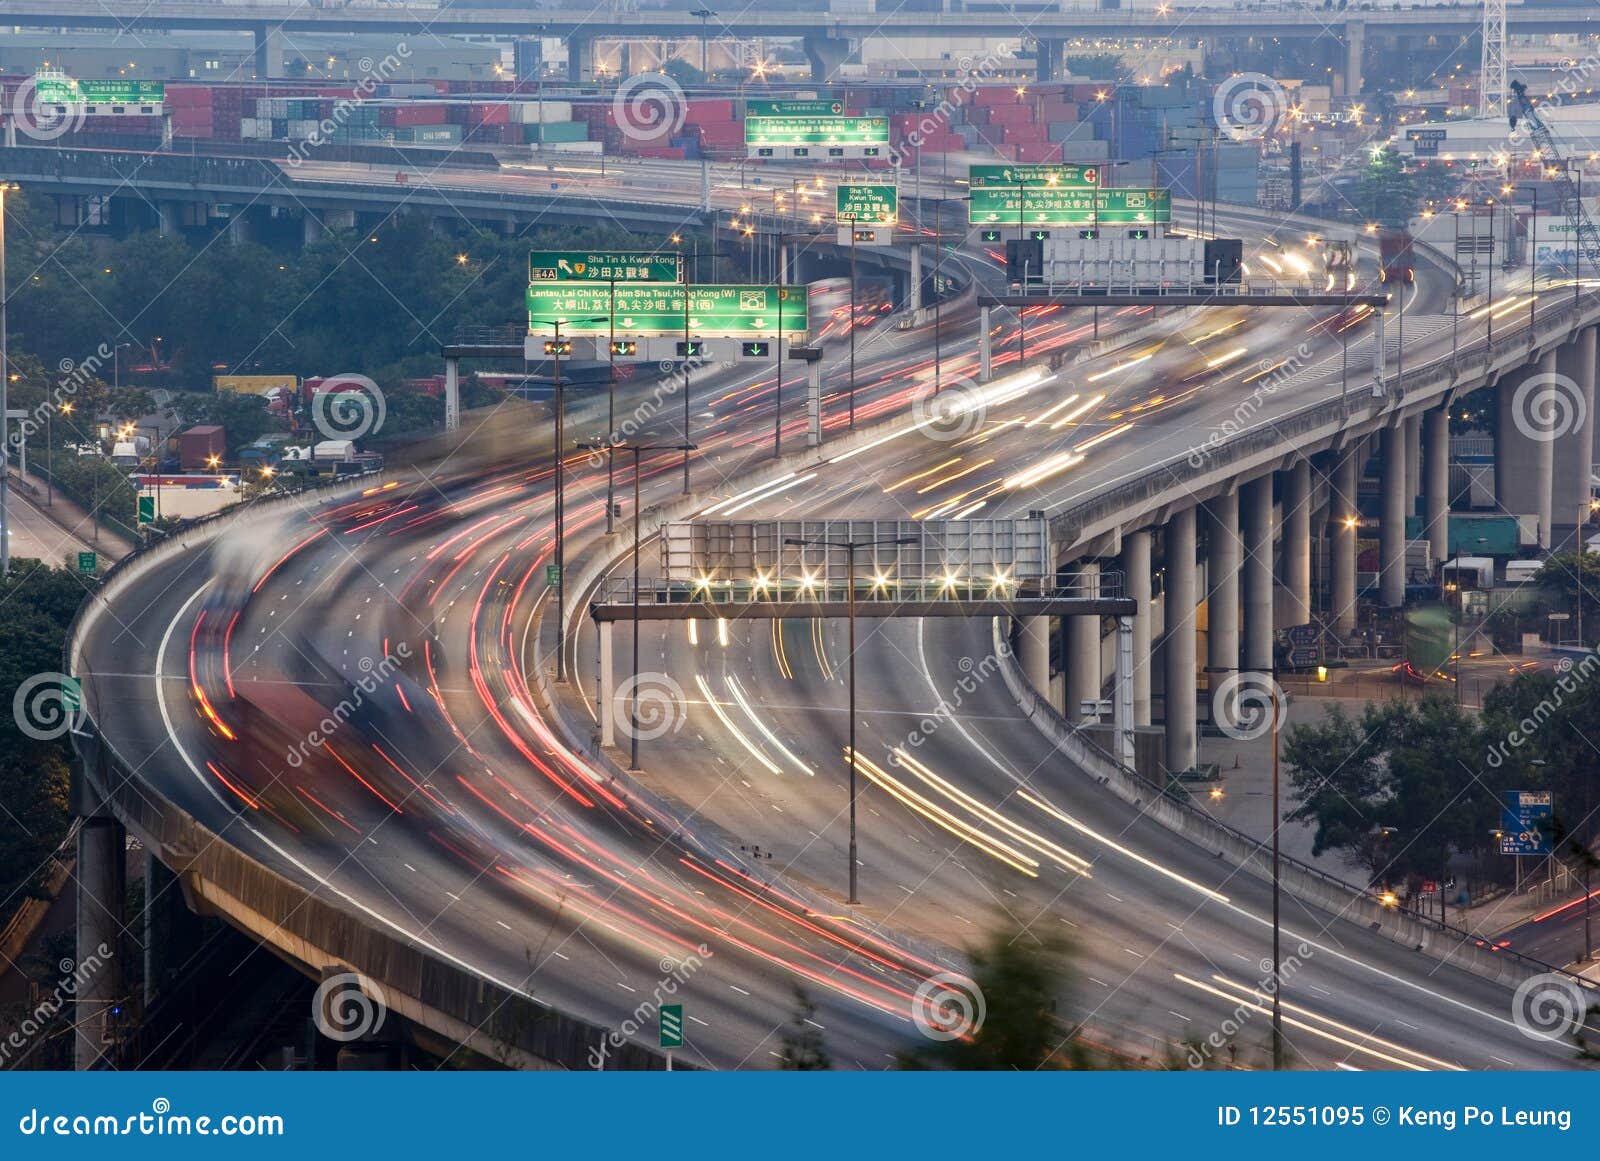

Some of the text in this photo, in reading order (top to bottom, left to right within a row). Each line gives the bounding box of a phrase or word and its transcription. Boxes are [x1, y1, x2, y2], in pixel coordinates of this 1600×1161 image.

[587, 255, 675, 265] Sha Tin & Kwun Tong
[613, 289, 633, 297] Tsim
[634, 289, 651, 297] Sha
